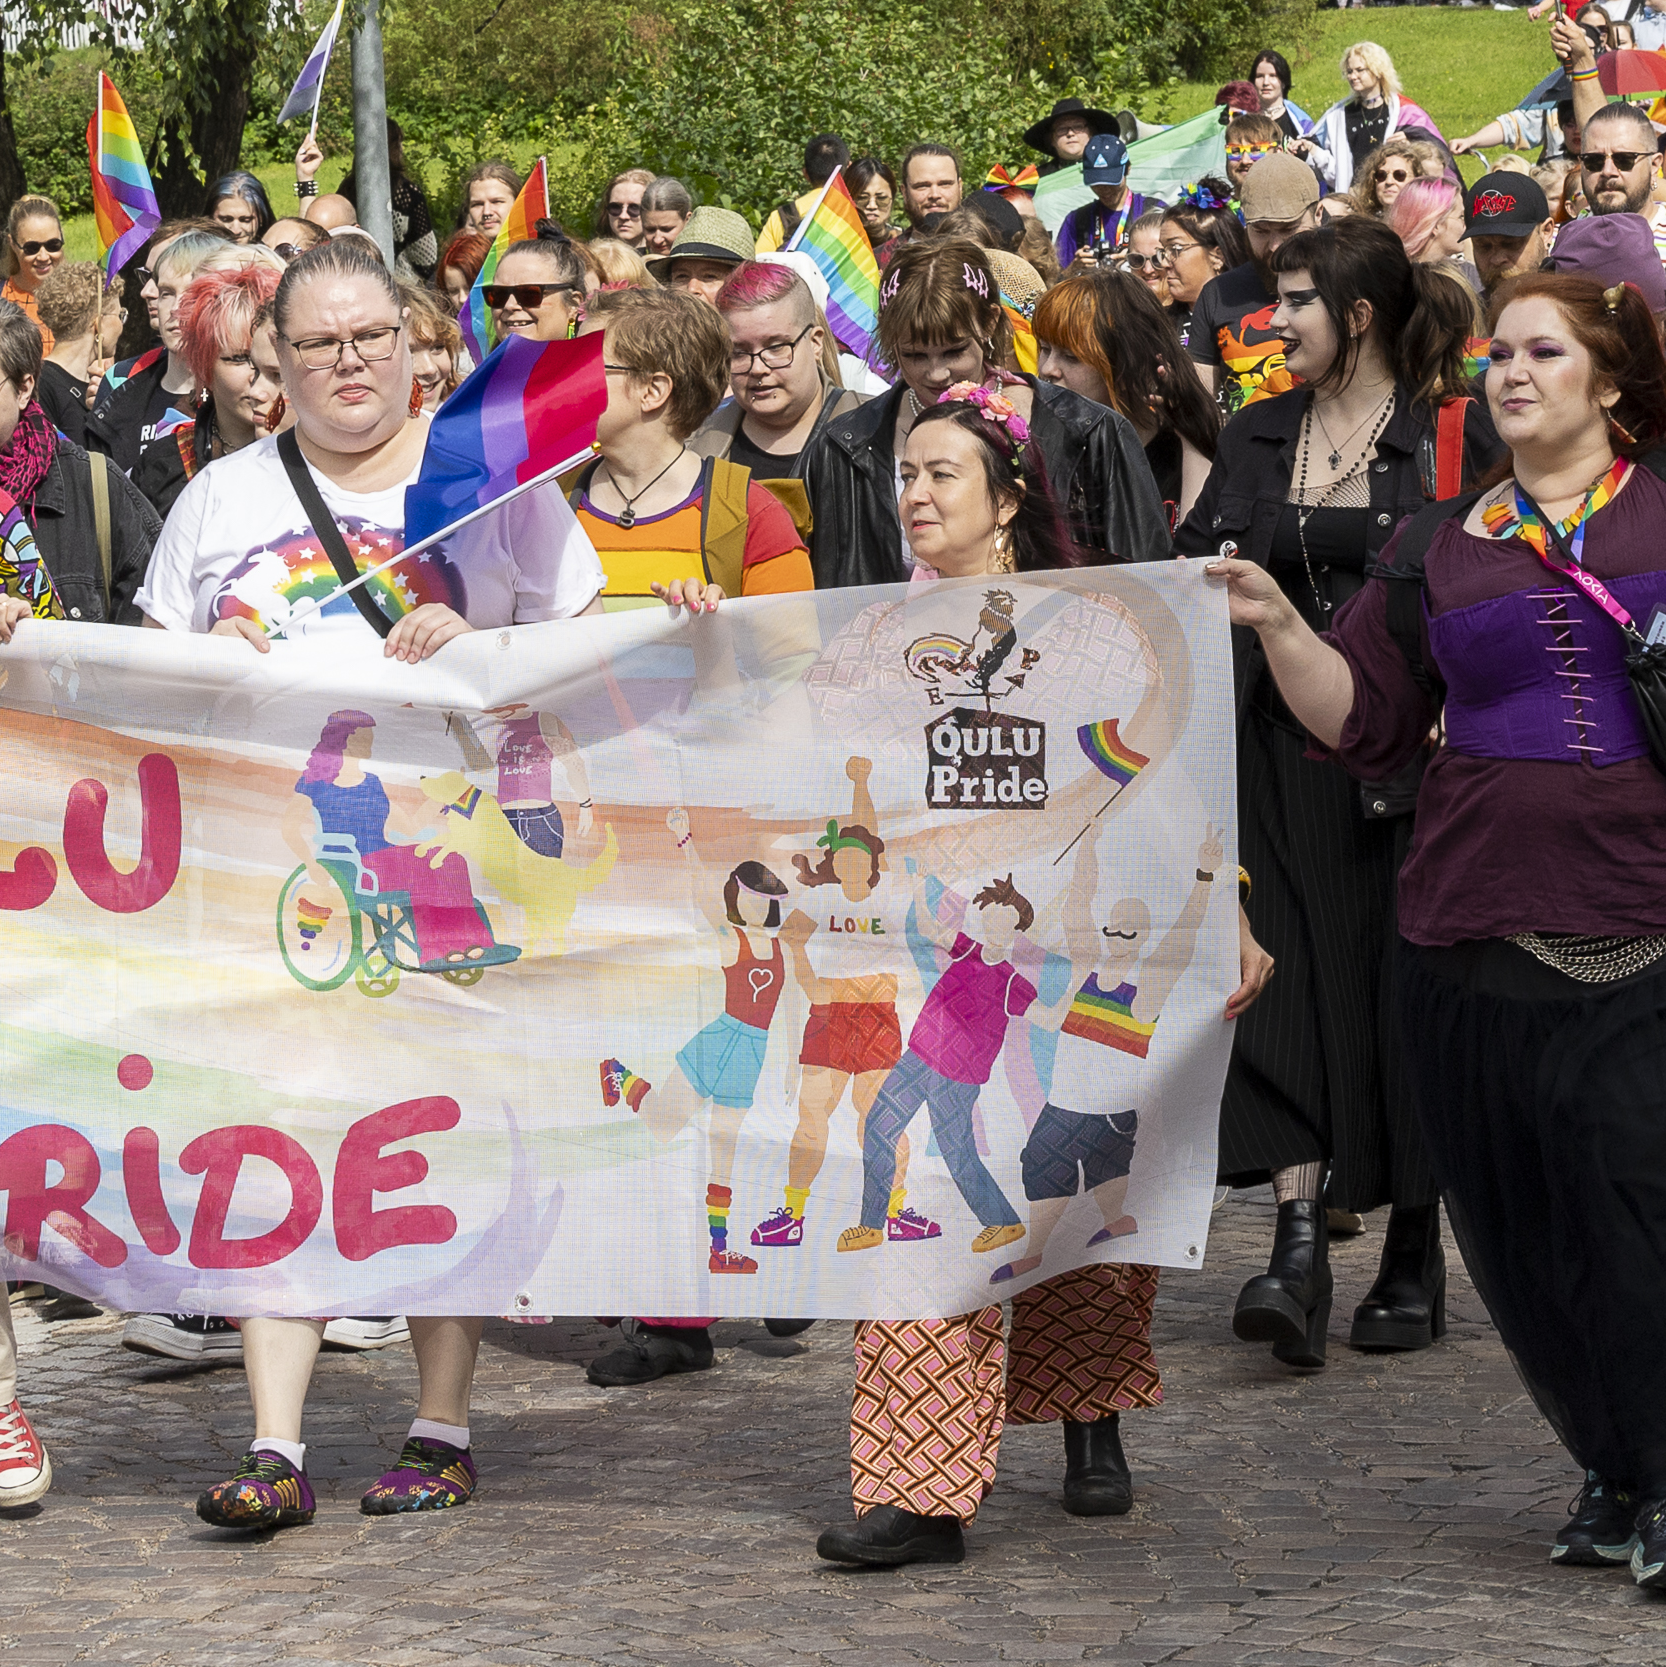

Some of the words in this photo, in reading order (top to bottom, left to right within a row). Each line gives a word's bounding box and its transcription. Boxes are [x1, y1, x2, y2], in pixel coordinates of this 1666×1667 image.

[1573, 570, 1608, 605] NOKIA
[931, 720, 1041, 758] OULU
[931, 765, 1049, 803] Pride
[829, 914, 886, 935] LOVE
